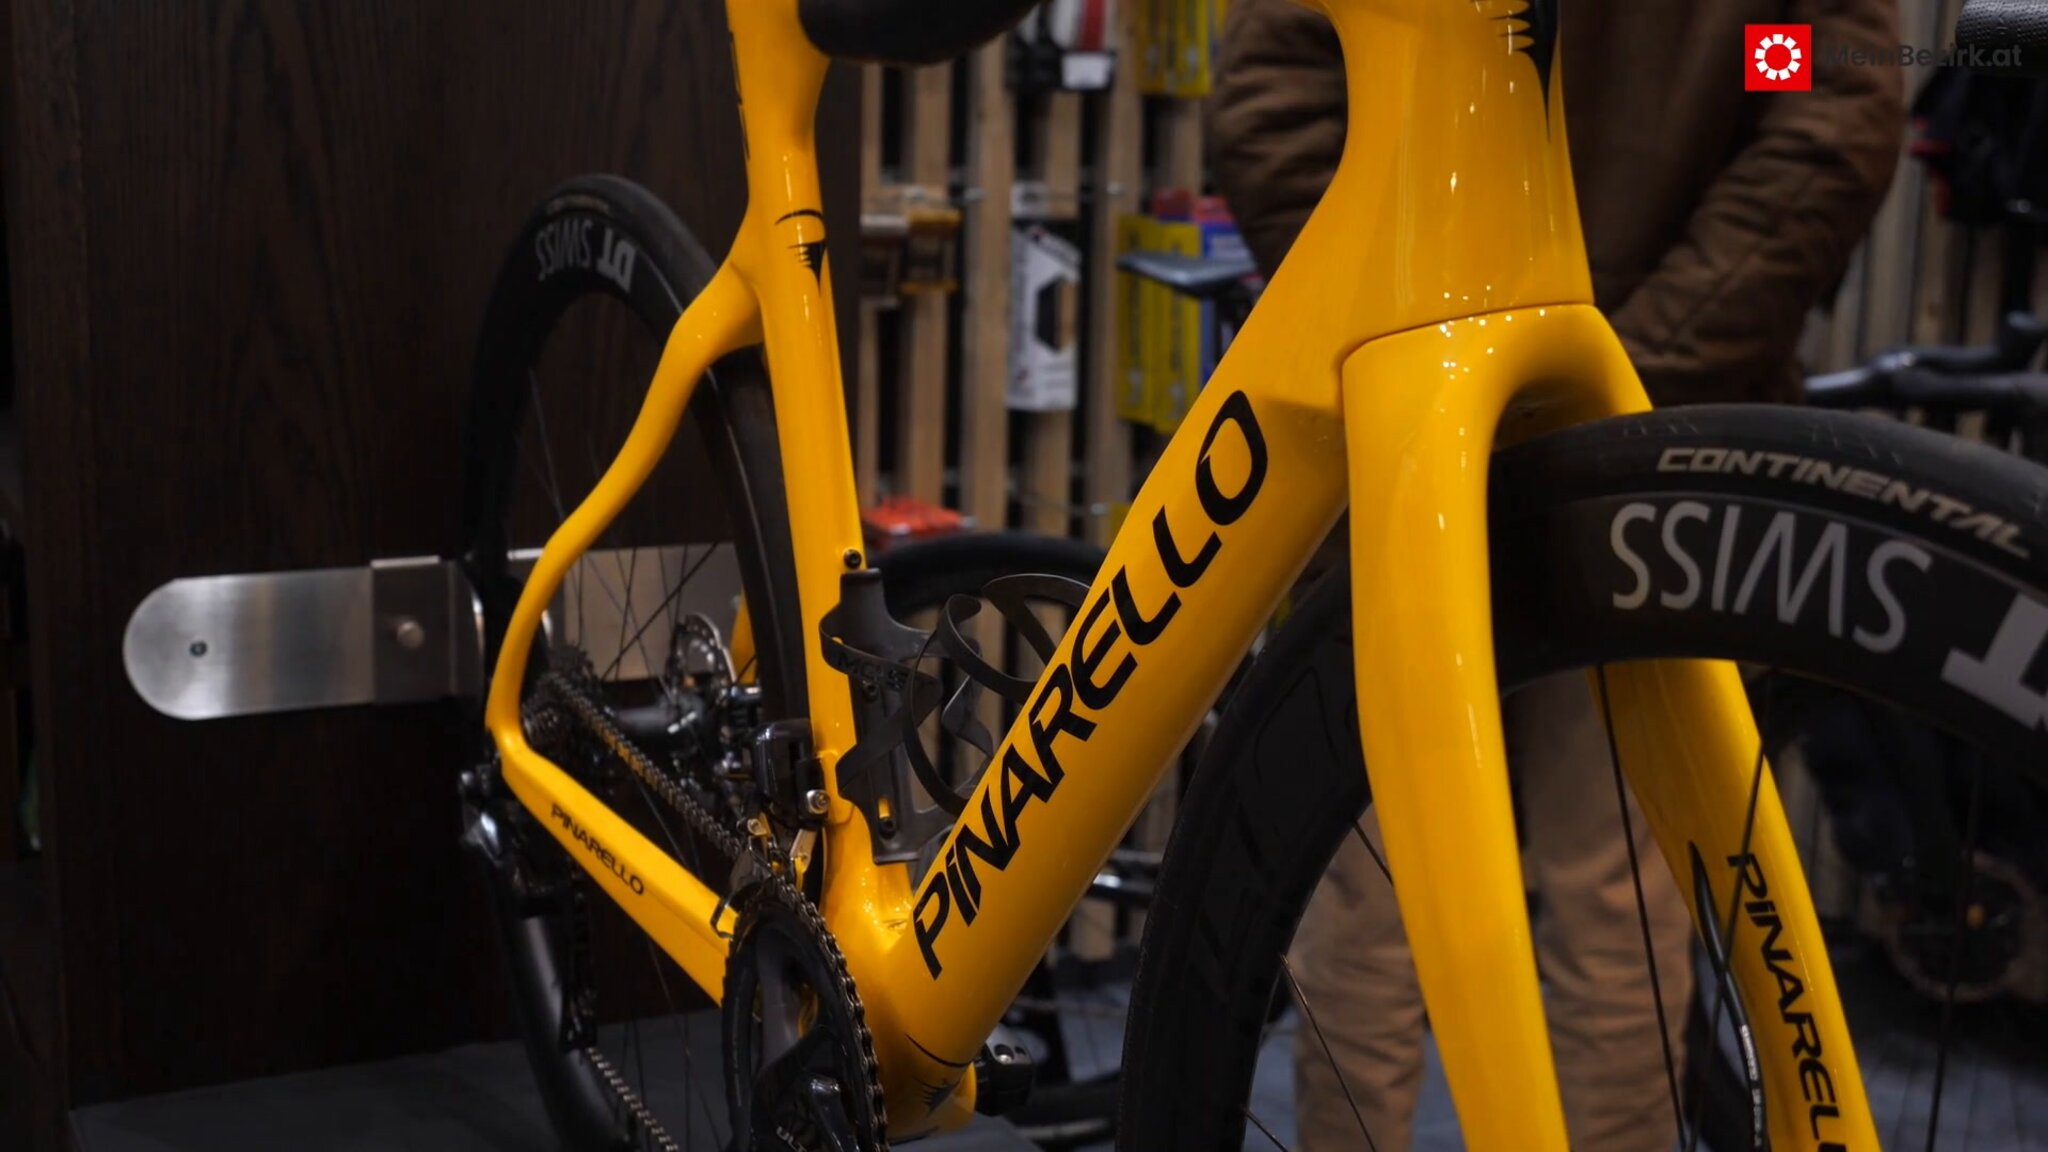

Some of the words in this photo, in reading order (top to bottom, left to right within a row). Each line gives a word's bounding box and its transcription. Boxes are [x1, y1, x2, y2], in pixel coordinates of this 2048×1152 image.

[535, 218, 594, 282] SWISS
[597, 227, 637, 294] DT
[1656, 447, 2030, 559] CONTINENTAL
[1610, 501, 1932, 654] SWISS
[912, 389, 1268, 980] PINARELLO
[550, 802, 645, 897] PINARELLO
